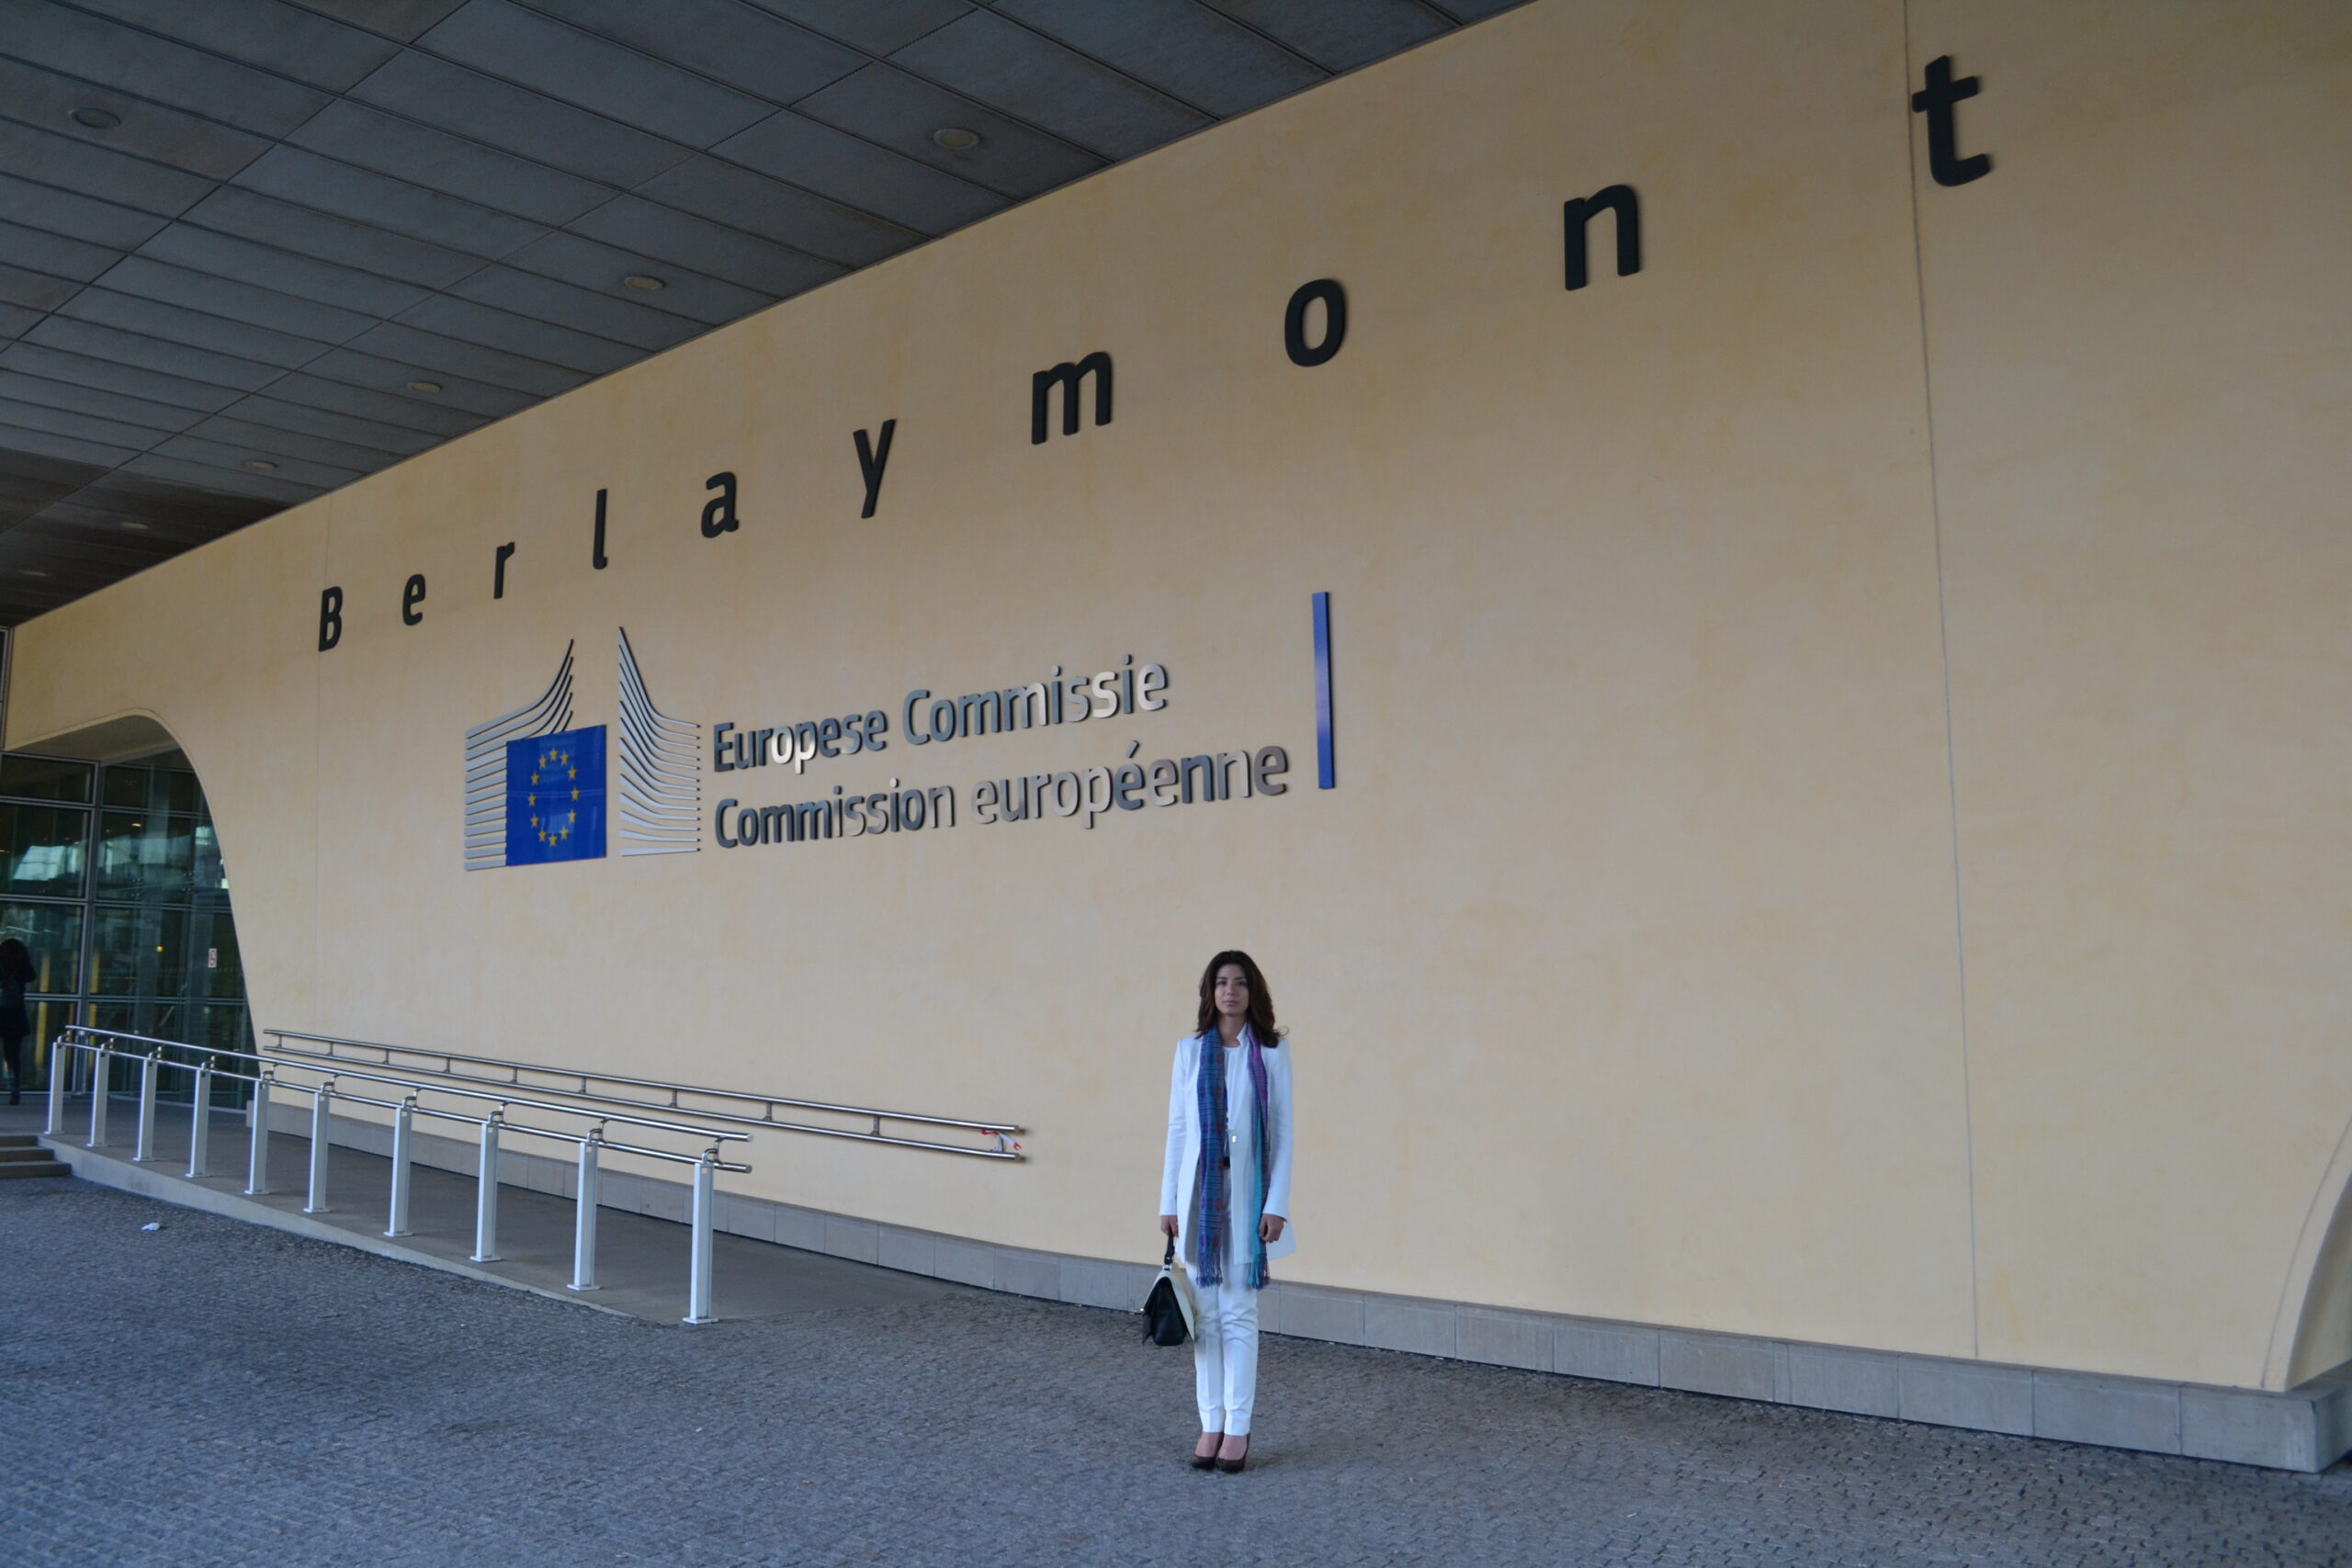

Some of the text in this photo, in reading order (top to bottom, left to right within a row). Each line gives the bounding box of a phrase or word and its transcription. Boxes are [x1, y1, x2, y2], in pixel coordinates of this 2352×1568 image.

[318, 55, 1992, 651] Berlaymont
[713, 654, 1167, 773] Europese Commissie
[714, 739, 1288, 848] Commission européenne
